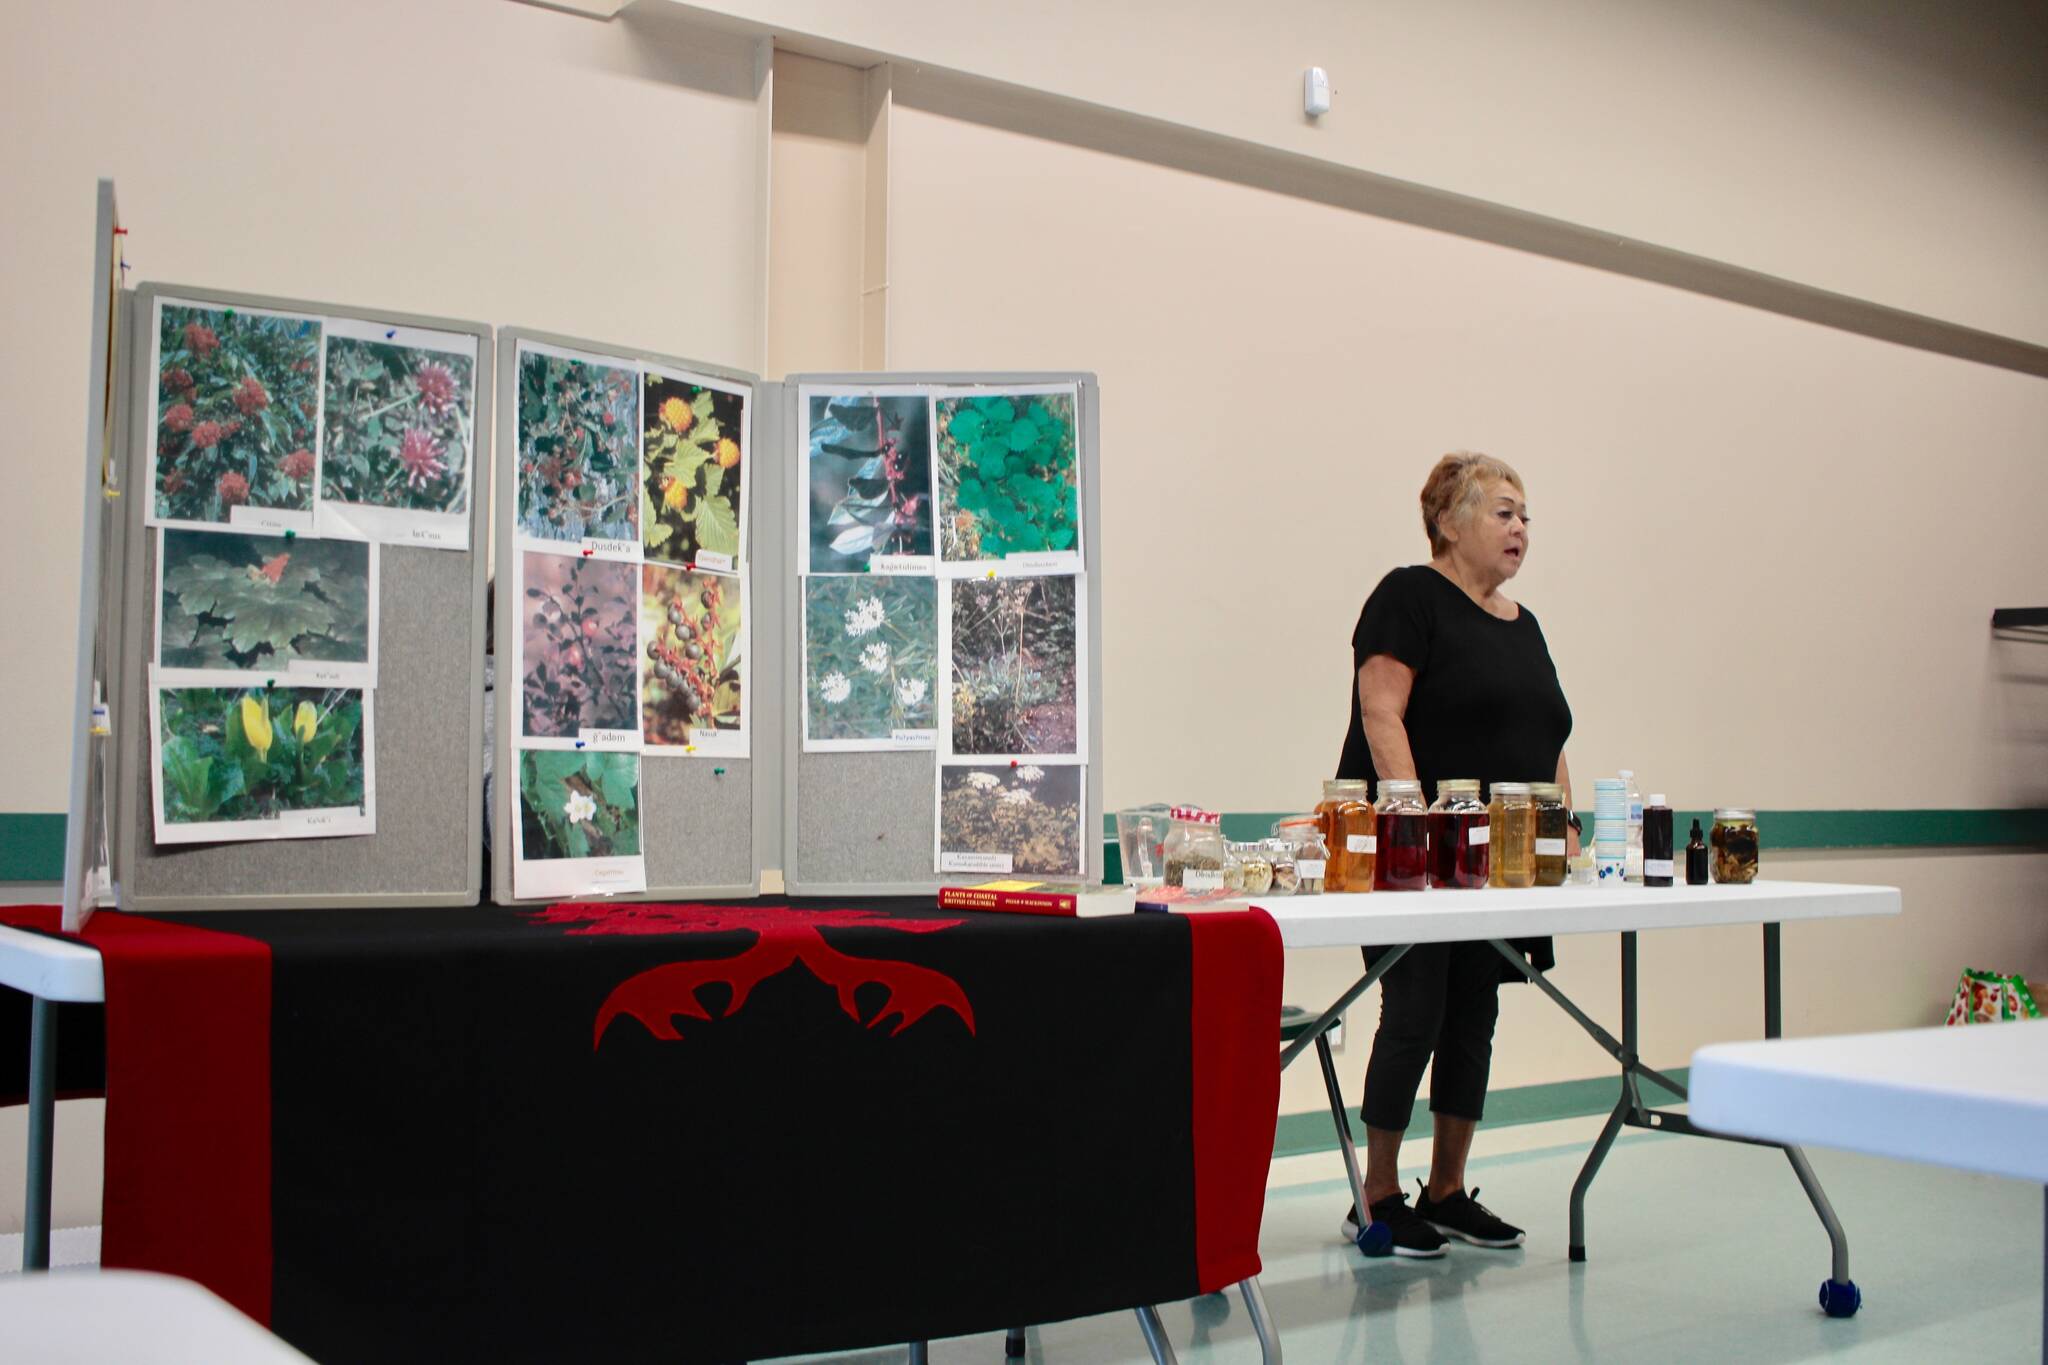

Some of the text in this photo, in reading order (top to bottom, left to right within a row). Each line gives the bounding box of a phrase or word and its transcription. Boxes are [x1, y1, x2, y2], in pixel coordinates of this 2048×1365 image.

[944, 891, 966, 899] PLANTS
[973, 892, 997, 900] COASTAL
[966, 899, 996, 907] COLUMBIA
